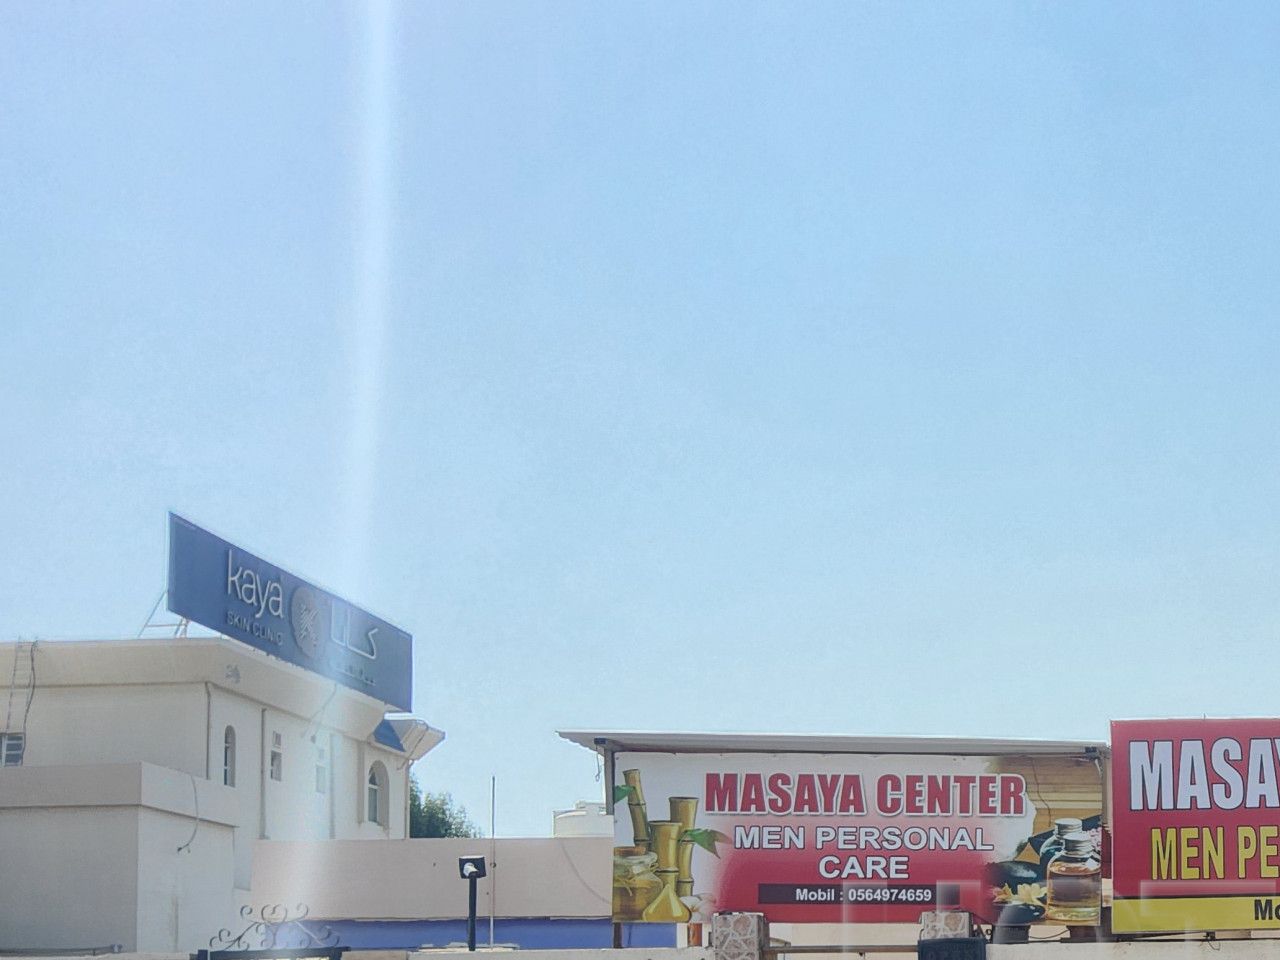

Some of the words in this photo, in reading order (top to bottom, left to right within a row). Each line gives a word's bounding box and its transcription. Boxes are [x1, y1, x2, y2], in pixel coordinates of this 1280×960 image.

[227, 549, 284, 618] kaya
[227, 610, 250, 633] SKIN
[704, 771, 866, 817] MASAYA
[876, 773, 1028, 818] CENTER
[734, 826, 804, 851] MEN
[815, 826, 994, 851] PERSONAL
[1151, 826, 1225, 881] MEN
[818, 855, 910, 880] CARE
[796, 888, 835, 901] Mobil
[848, 888, 932, 902] 0564974659
